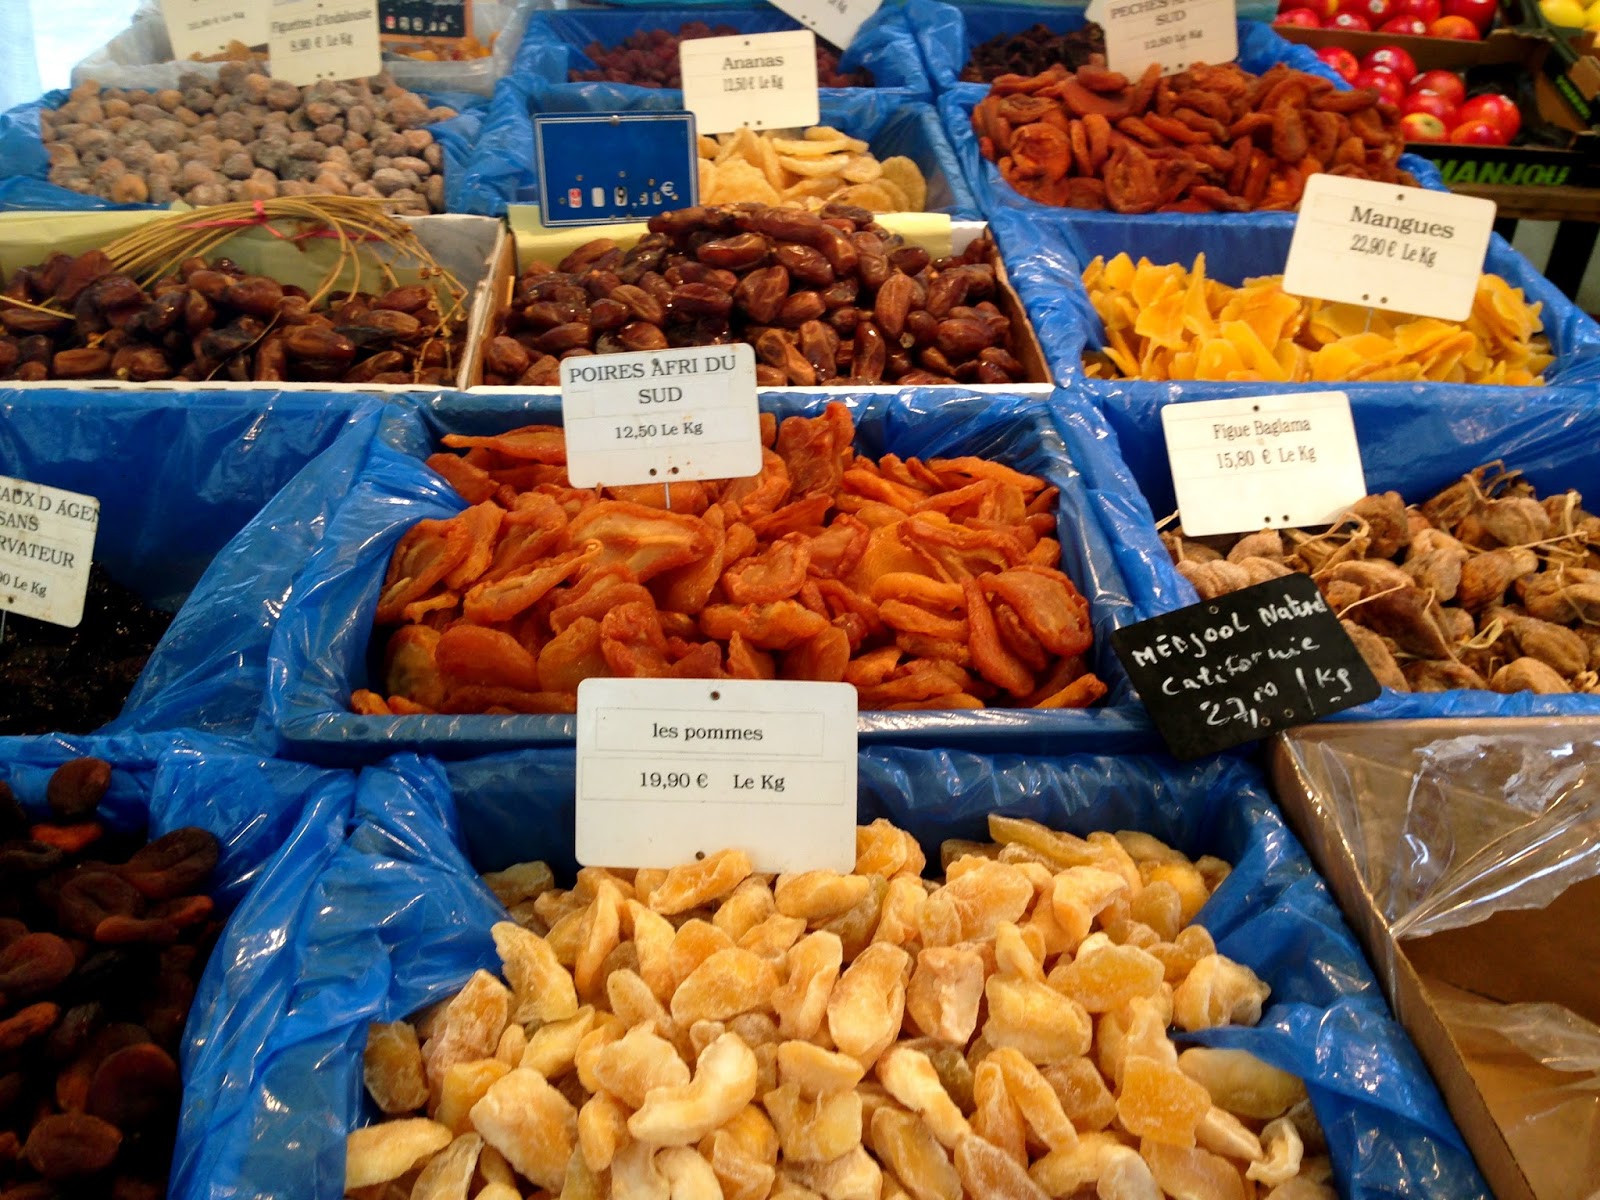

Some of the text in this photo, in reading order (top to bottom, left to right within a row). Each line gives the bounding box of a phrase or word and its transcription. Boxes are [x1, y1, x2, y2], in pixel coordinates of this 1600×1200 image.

[1155, 10, 1187, 26] SUD
[721, 55, 785, 71] Ananas
[1350, 205, 1456, 240] Mangues
[1401, 242, 1418, 262] Le
[1418, 246, 1438, 268] Kg
[569, 362, 645, 384] POIRES
[705, 355, 737, 373] DU
[638, 386, 684, 405] SUD
[615, 421, 704, 440] 12,50 Le Kg
[1213, 417, 1312, 441] Figue Baglama
[1216, 445, 1318, 470] 15,80 € Le Kg
[0, 485, 35, 508] AUX
[0, 511, 39, 532] SANS
[13, 576, 28, 591] Le
[31, 581, 47, 599] Kg
[652, 722, 764, 742] les pommes
[639, 771, 786, 793] 19,90 € Le Kg
